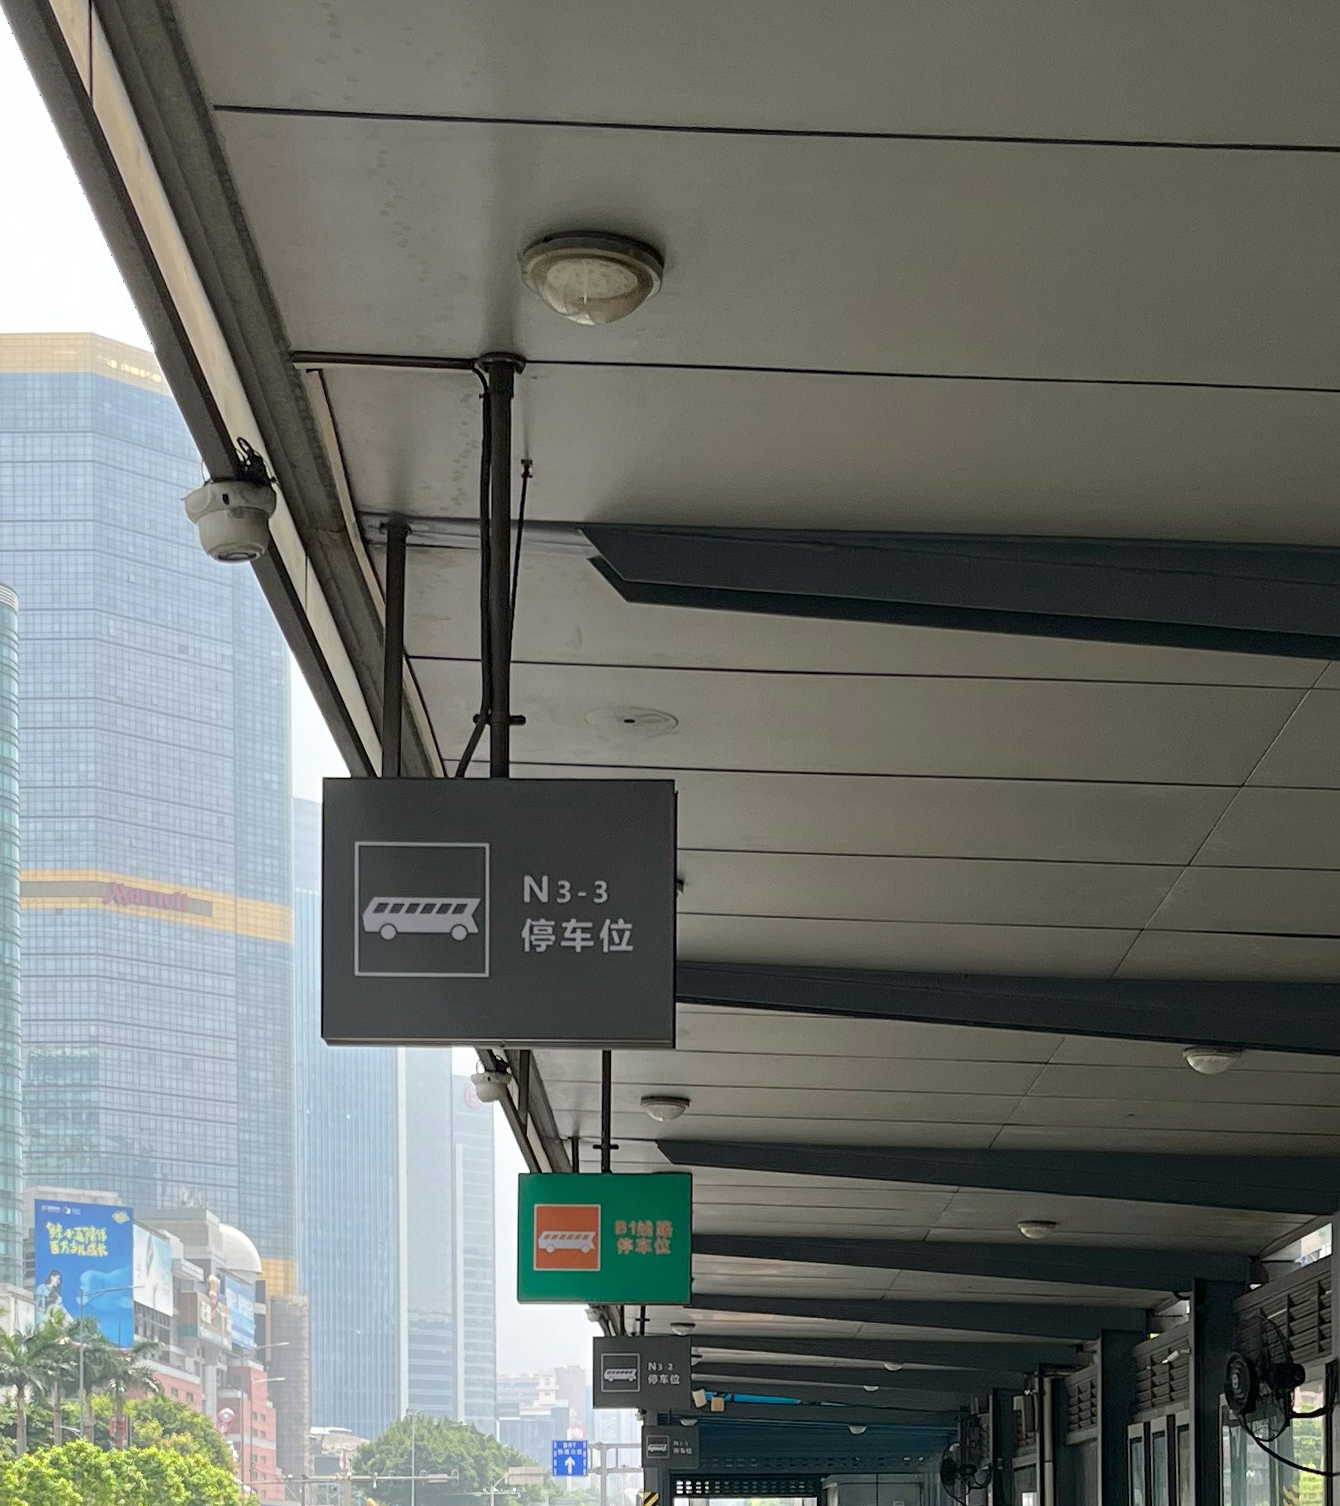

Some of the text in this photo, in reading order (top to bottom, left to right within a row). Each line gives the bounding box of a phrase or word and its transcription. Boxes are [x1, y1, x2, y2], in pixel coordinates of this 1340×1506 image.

[522, 874, 610, 904] N3-3
[521, 918, 634, 953] 停车位
